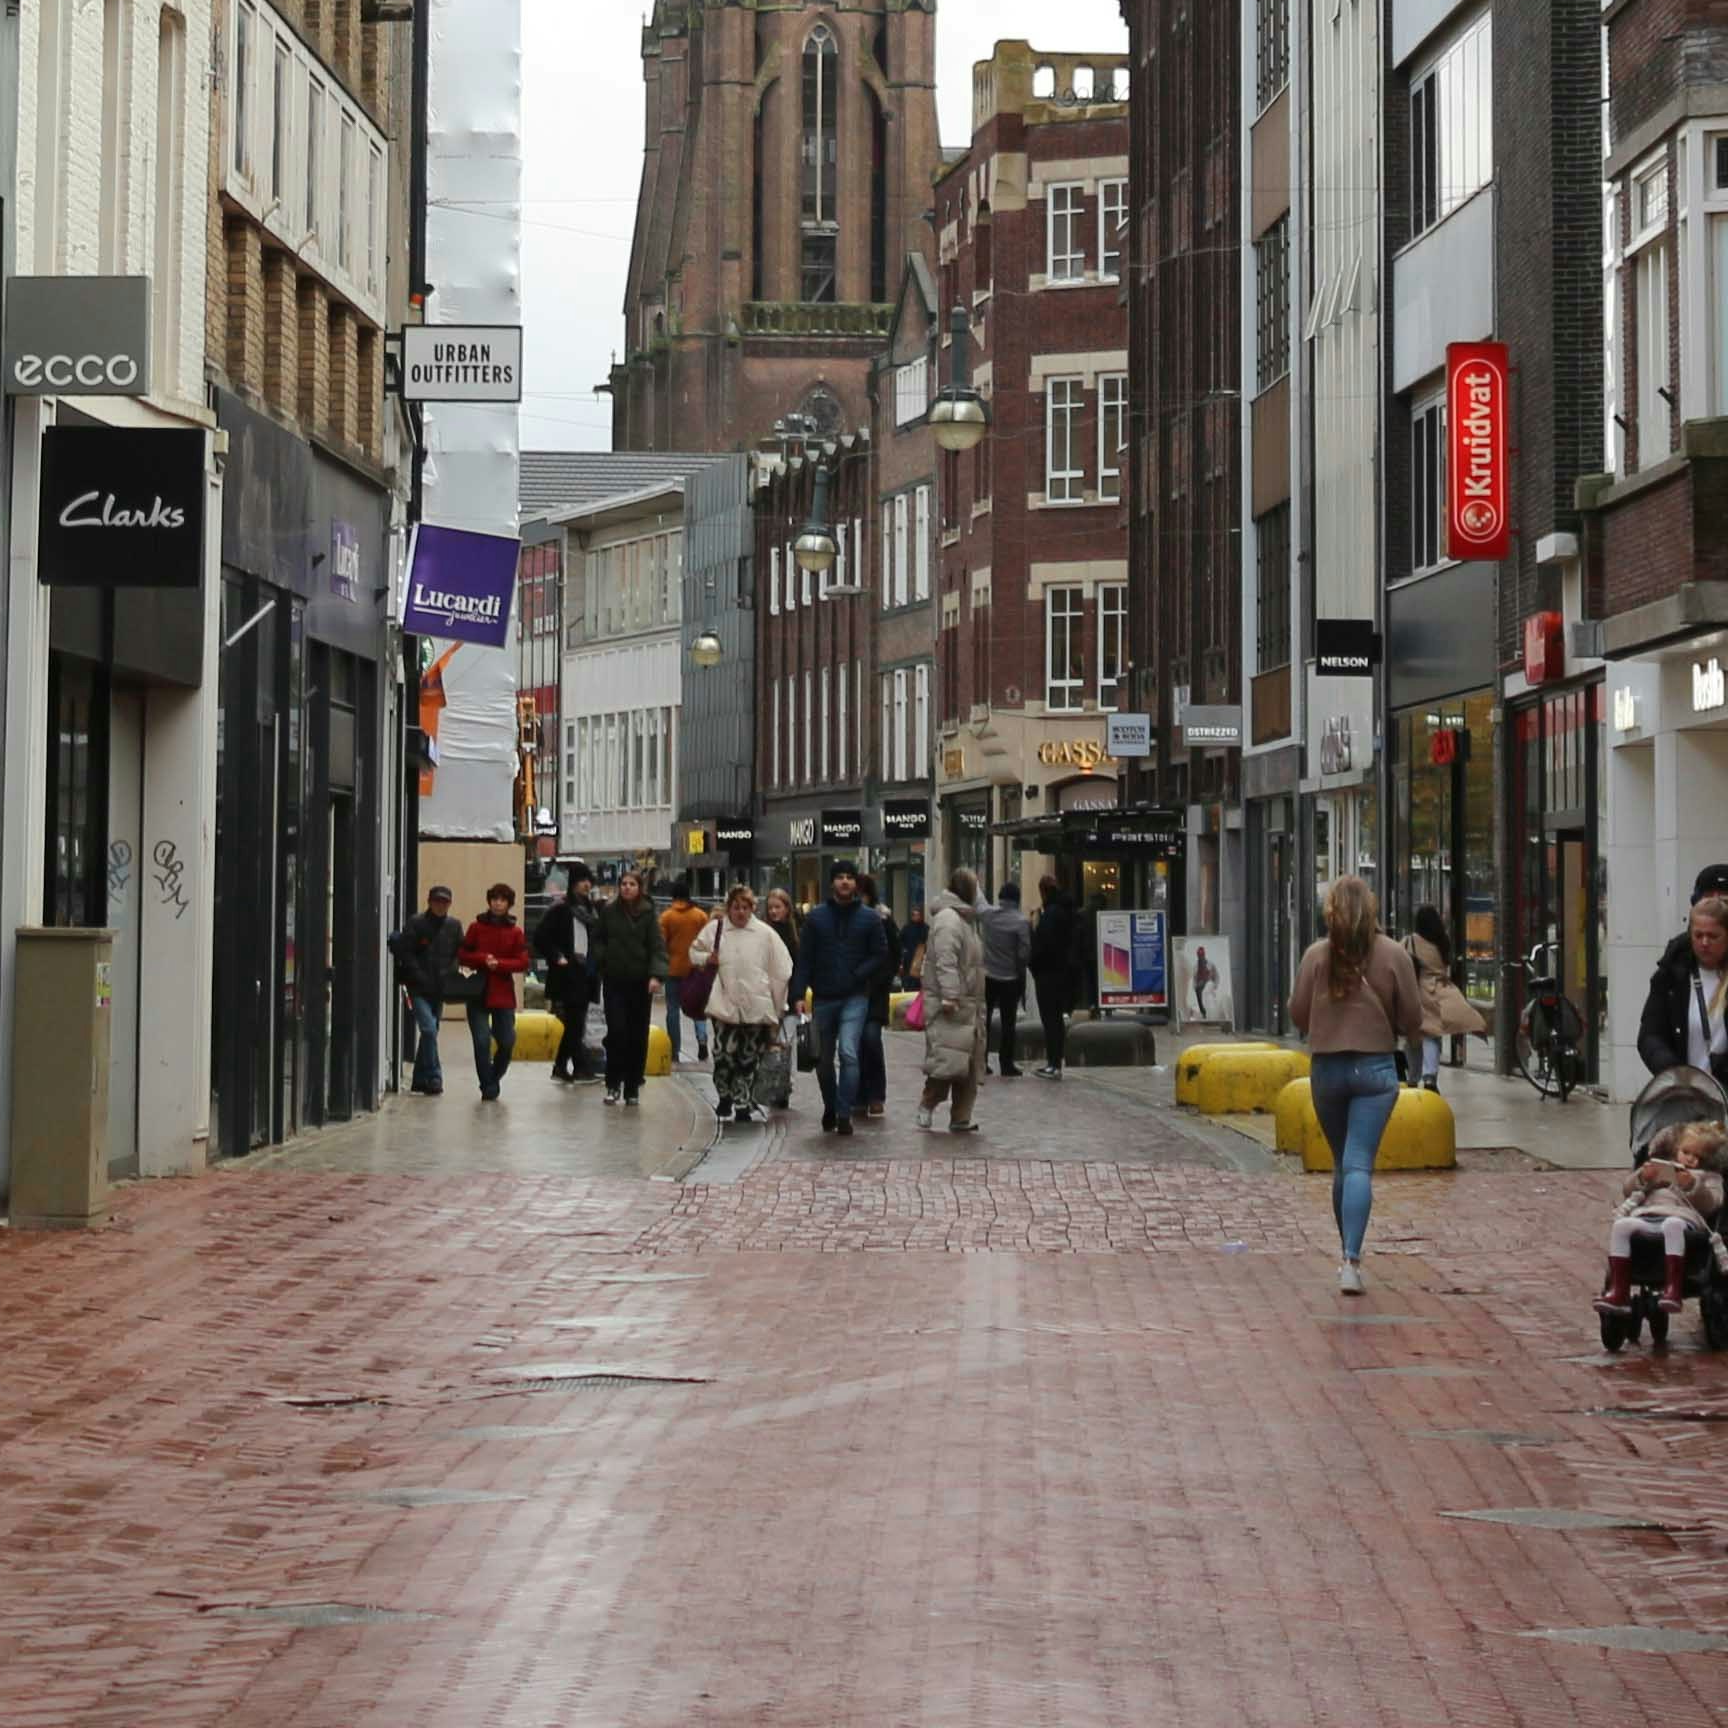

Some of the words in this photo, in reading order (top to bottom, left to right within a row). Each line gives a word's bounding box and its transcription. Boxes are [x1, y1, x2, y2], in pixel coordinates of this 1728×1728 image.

[434, 344, 490, 362] URBAN
[14, 354, 137, 386] ecco
[411, 365, 513, 383] OUTFITTERS
[1463, 373, 1492, 497] Kruidvat
[59, 491, 185, 528] Clarks
[413, 584, 502, 617] Lucardi
[1321, 656, 1369, 668] NELSON
[823, 823, 860, 833] MANGO
[885, 814, 927, 824] MANGO
[717, 830, 752, 840] MANGO
[790, 818, 814, 846] MANGO
